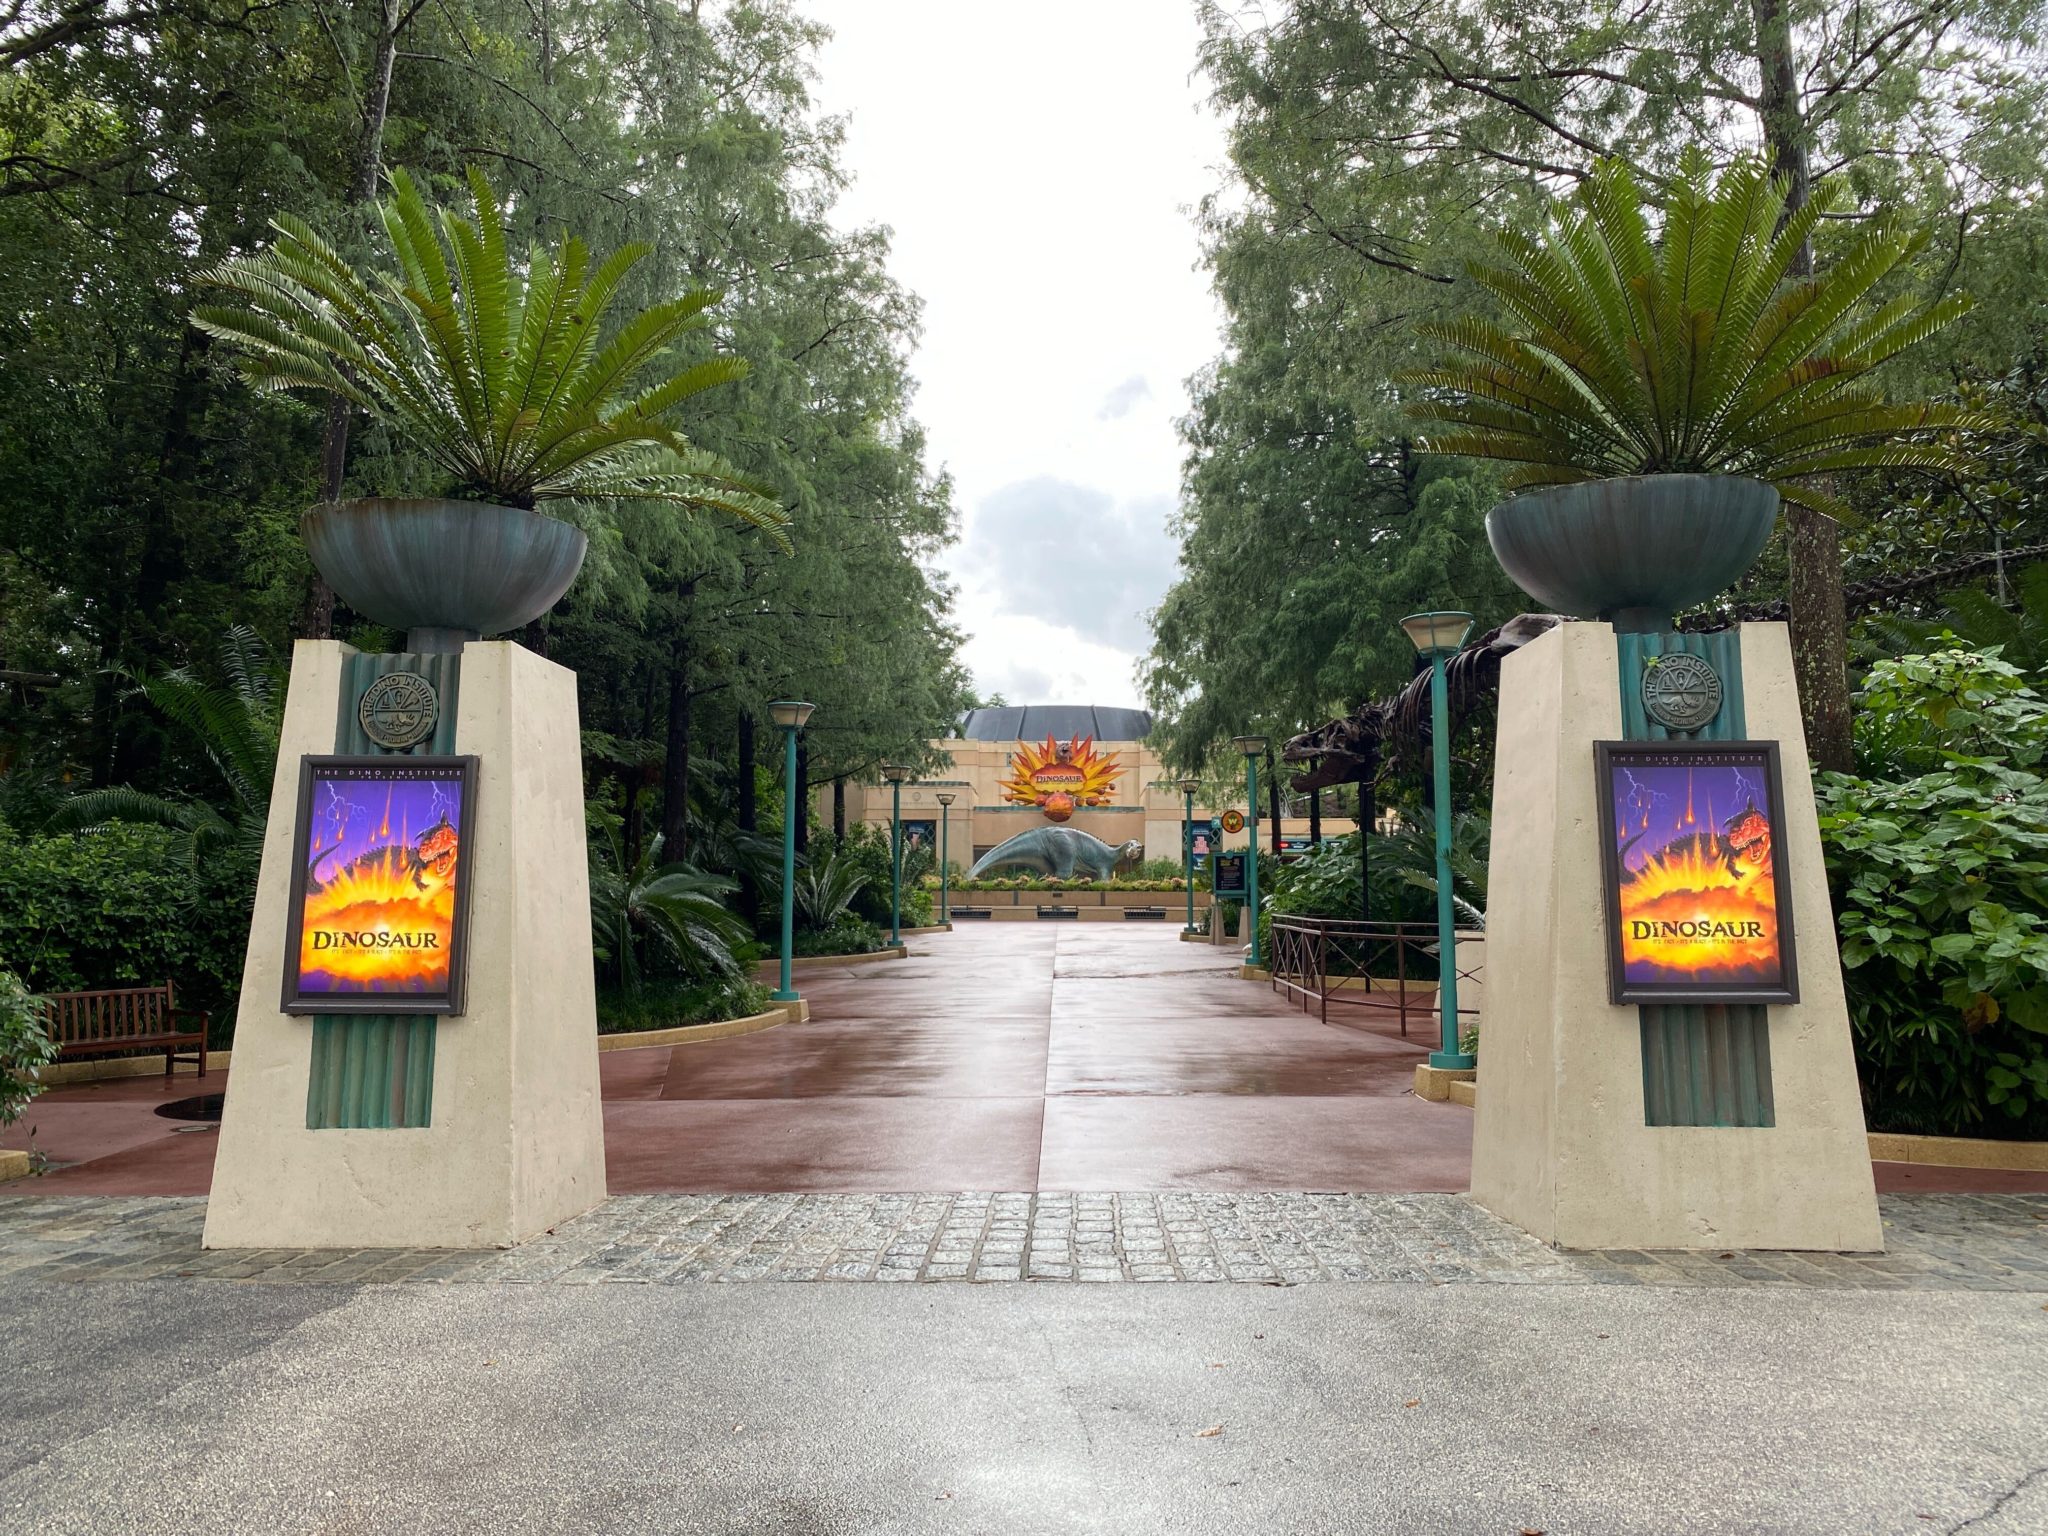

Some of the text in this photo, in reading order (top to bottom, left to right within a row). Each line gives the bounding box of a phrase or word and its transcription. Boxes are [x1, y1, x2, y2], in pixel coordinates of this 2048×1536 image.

[1646, 677, 1659, 699] THE
[1681, 657, 1718, 700] INSTITUTE
[364, 676, 433, 718] THE DINO INSTITUTE
[1036, 775, 1082, 783] DINOSAUR
[1631, 920, 1765, 940] DINOSAUR
[312, 931, 439, 950] DINOSAUR
